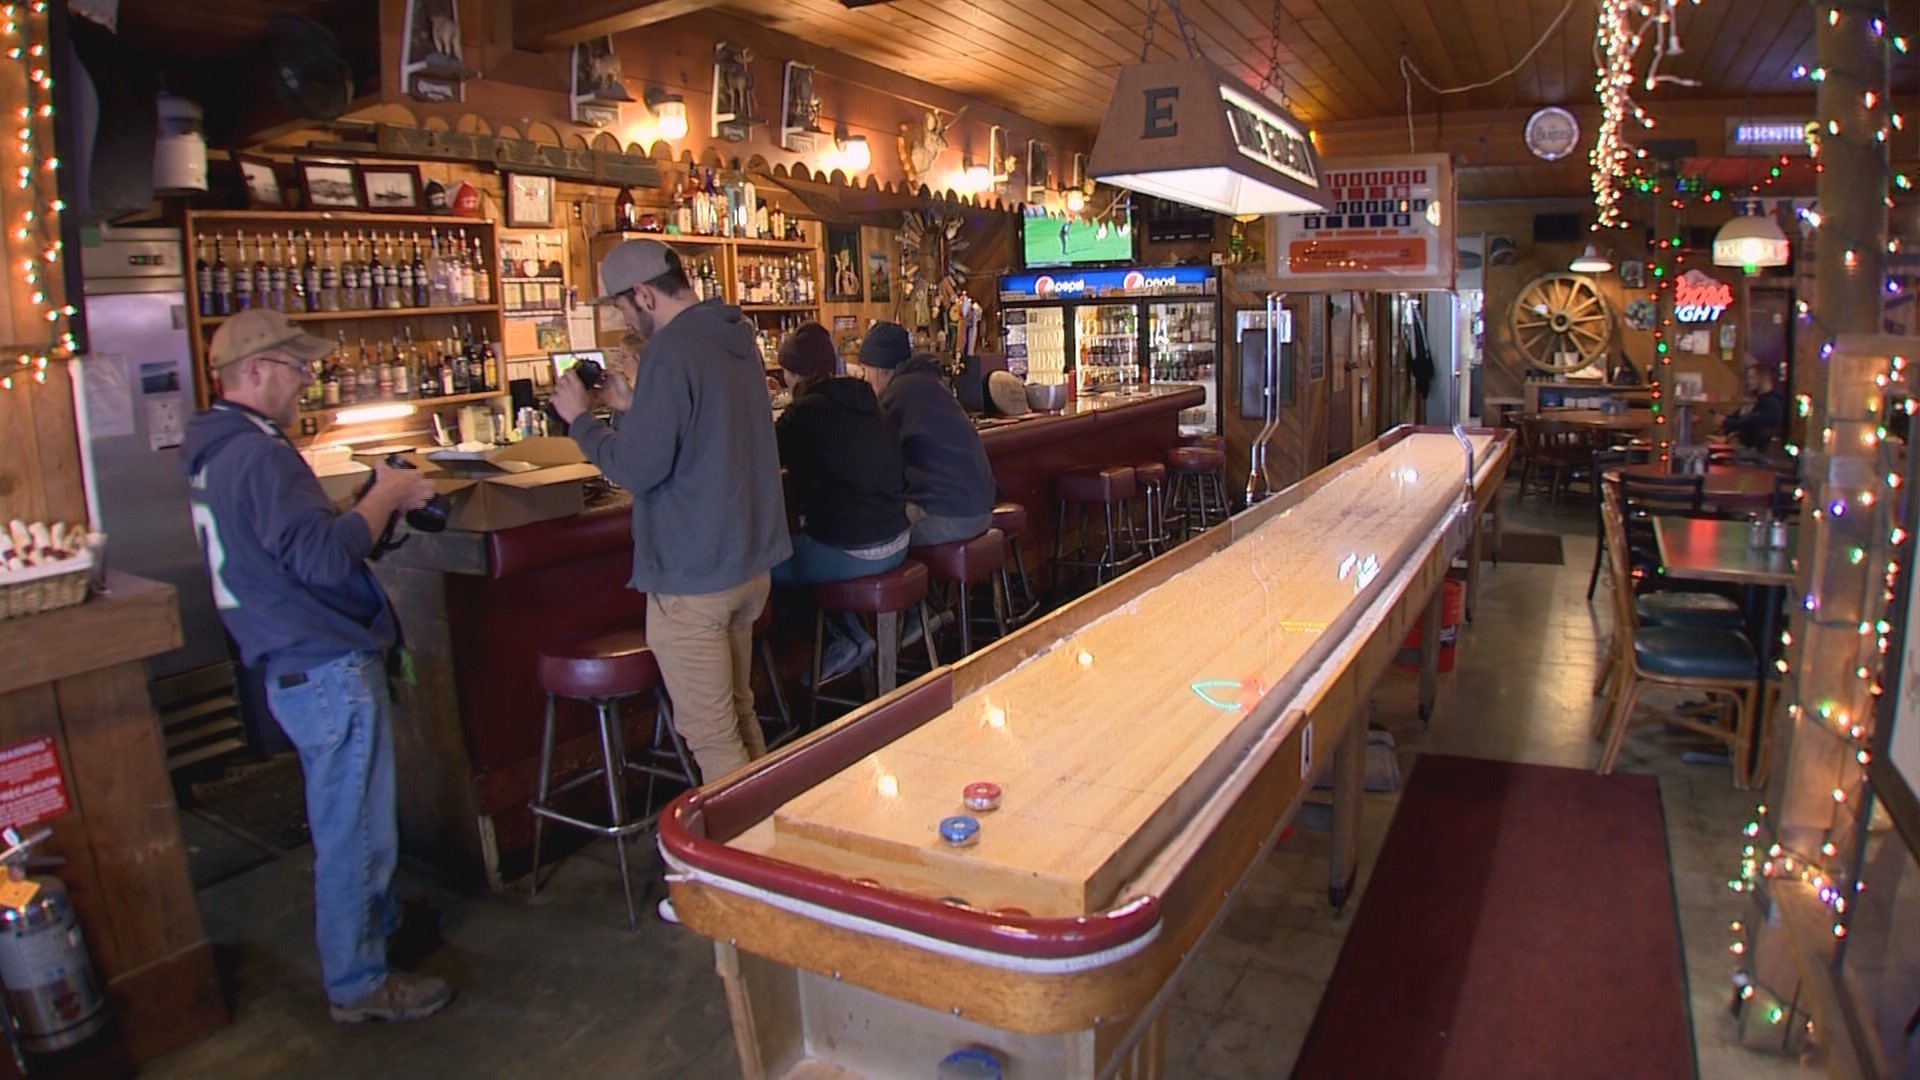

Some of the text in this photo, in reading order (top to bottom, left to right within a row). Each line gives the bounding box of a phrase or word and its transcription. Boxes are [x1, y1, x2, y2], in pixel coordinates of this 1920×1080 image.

[1140, 86, 1179, 140] E
[1054, 279, 1085, 293] pepsi
[1675, 304, 1727, 322] GHT
